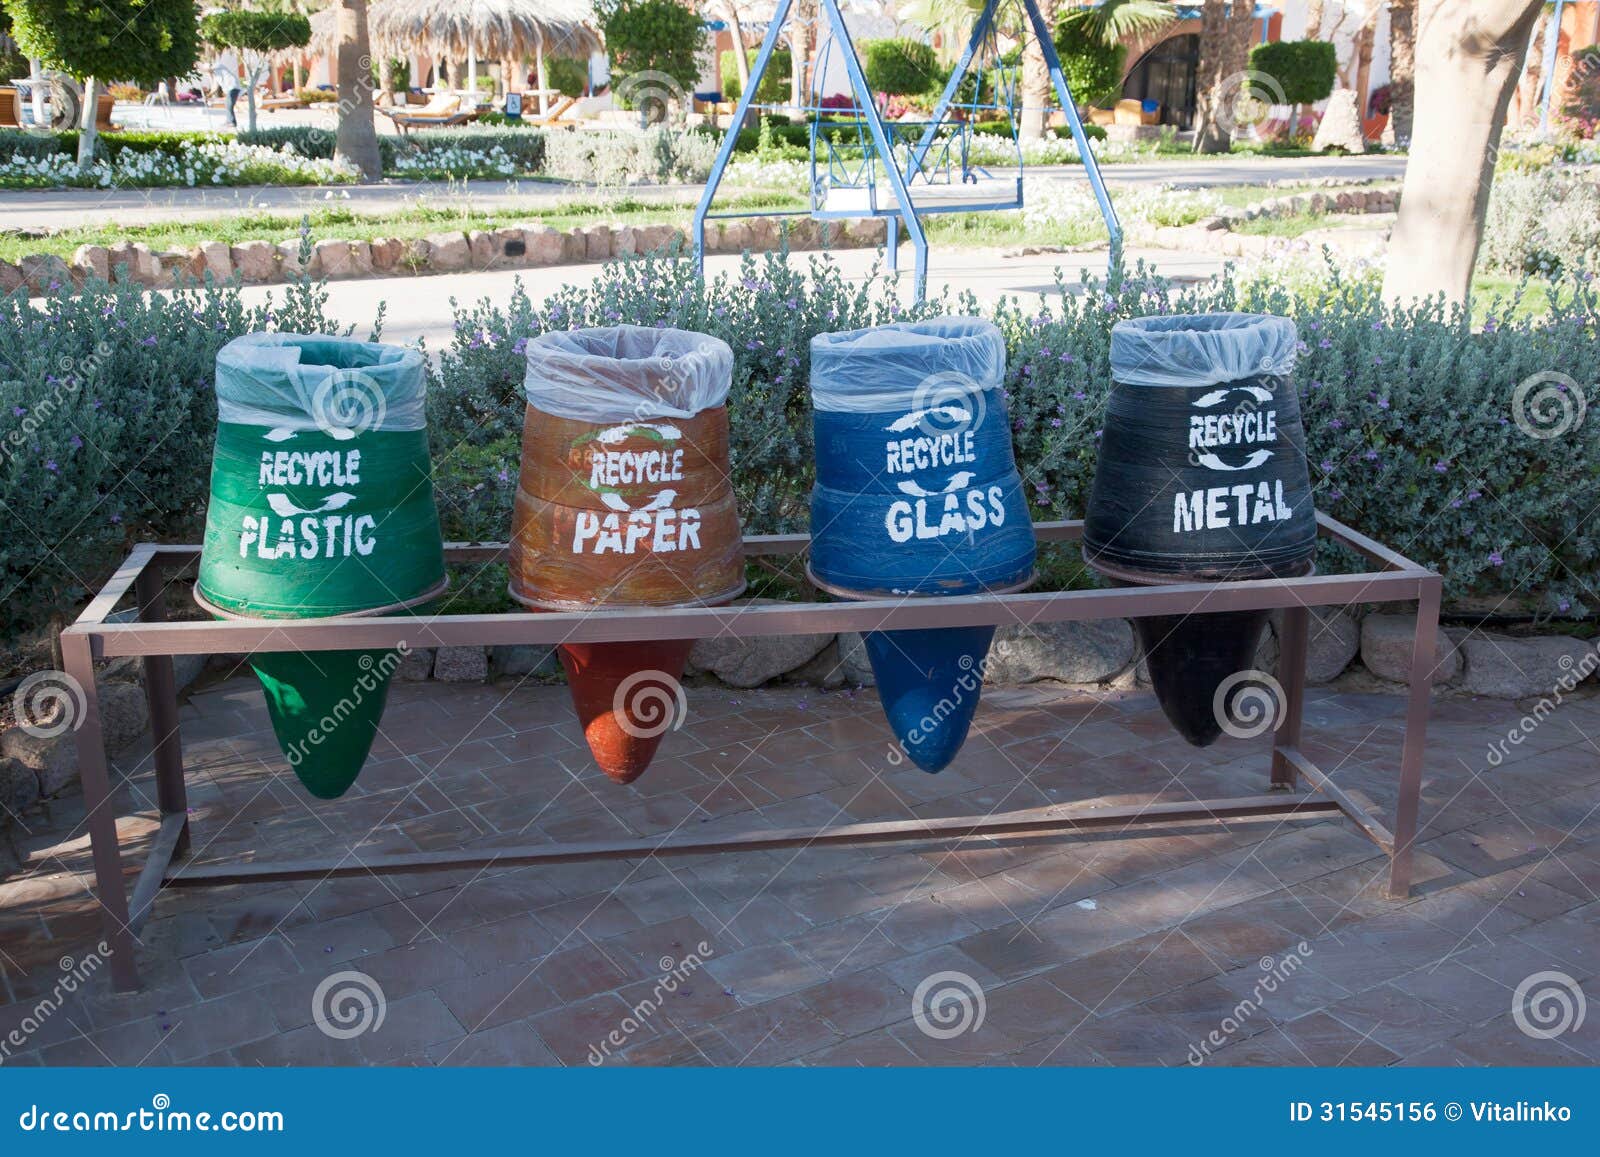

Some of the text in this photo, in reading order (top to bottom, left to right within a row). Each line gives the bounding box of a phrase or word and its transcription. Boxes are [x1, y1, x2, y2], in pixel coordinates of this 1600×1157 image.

[1189, 410, 1278, 448] RECYCLE
[259, 449, 361, 488] RECYCLE
[590, 449, 685, 489] RECYCLE
[886, 431, 976, 473] RECYCLE
[885, 486, 1005, 543] GLASS
[1174, 479, 1292, 533] METAL
[239, 515, 377, 560] PLASTIC
[572, 508, 701, 554] PAPER
